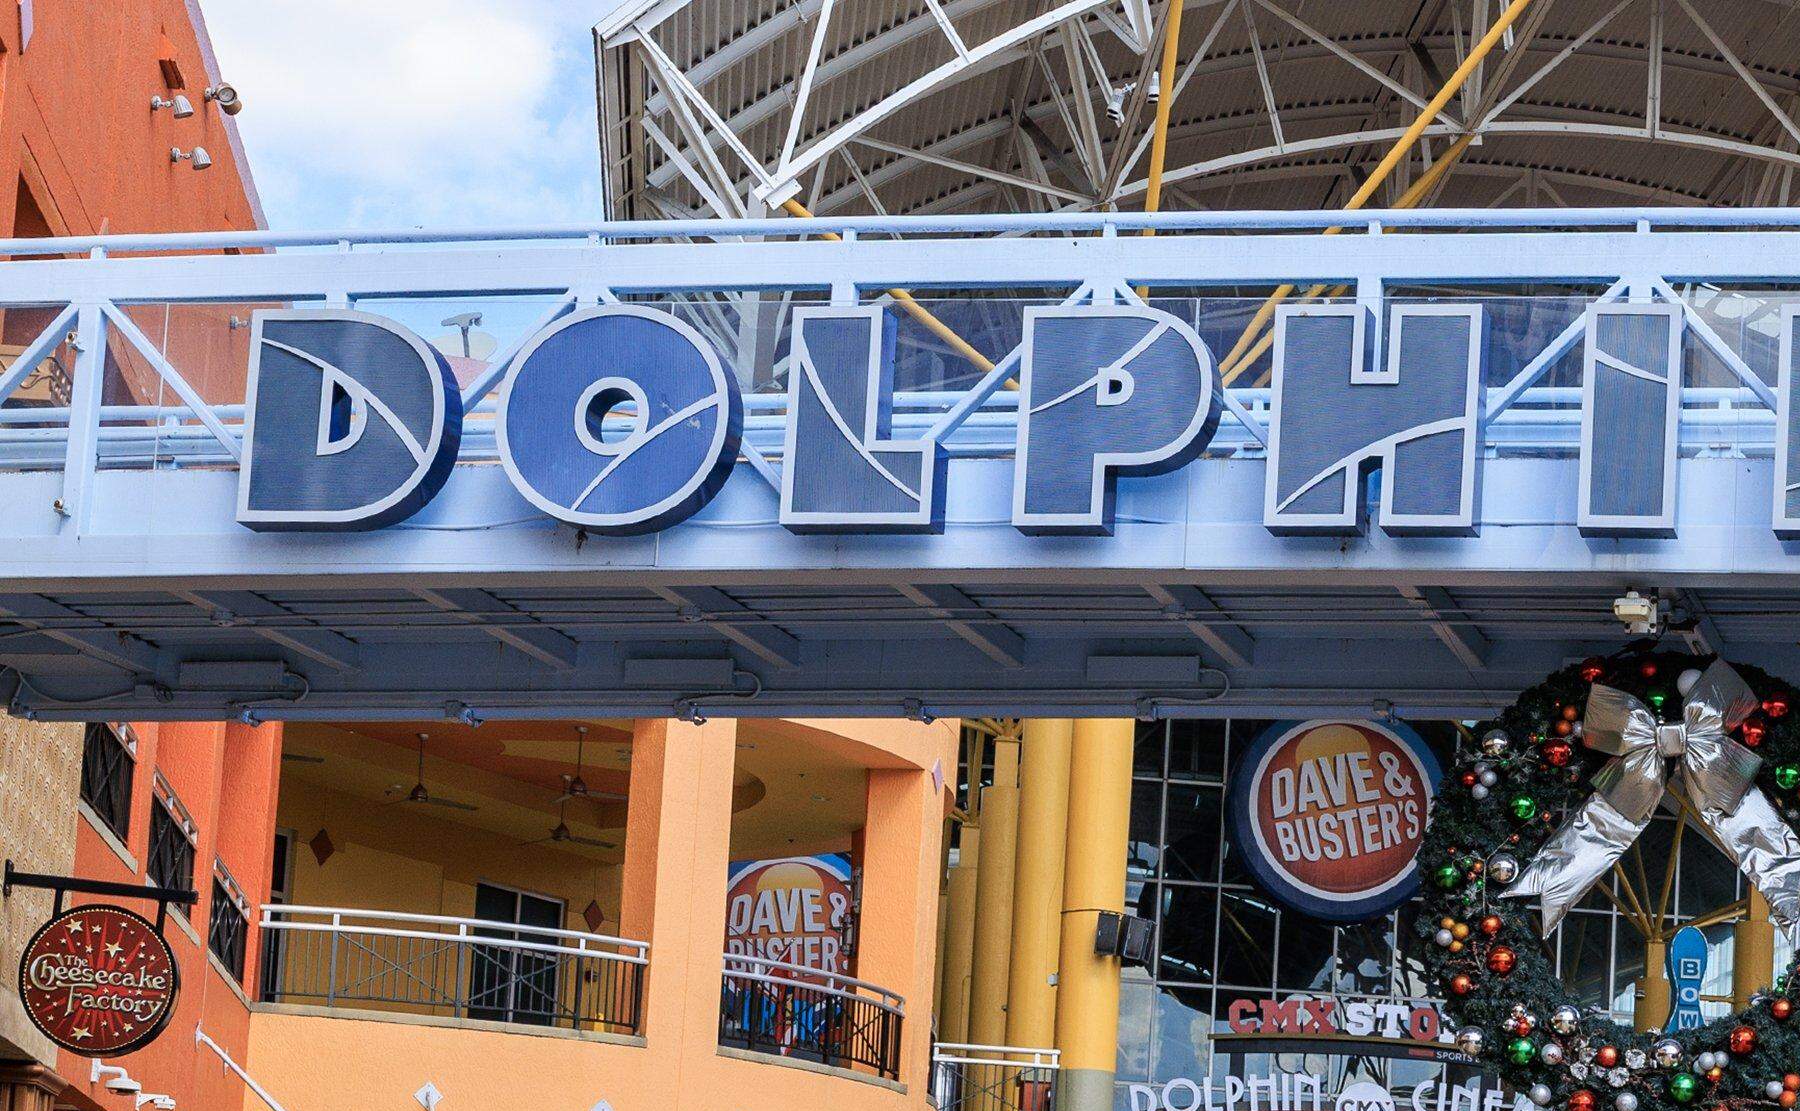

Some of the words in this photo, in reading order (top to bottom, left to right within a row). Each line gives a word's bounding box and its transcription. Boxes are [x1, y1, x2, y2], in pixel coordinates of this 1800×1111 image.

[1271, 751, 1382, 819] DAVE
[1378, 750, 1416, 798] &
[1275, 799, 1420, 863] BUSTER'S
[728, 887, 826, 936] DAVE
[30, 953, 167, 991] Cheesecake
[64, 954, 88, 967] The
[56, 981, 163, 1022] Factory
[1228, 998, 1338, 1035] CMX
[1436, 1050, 1473, 1063] SPORTS
